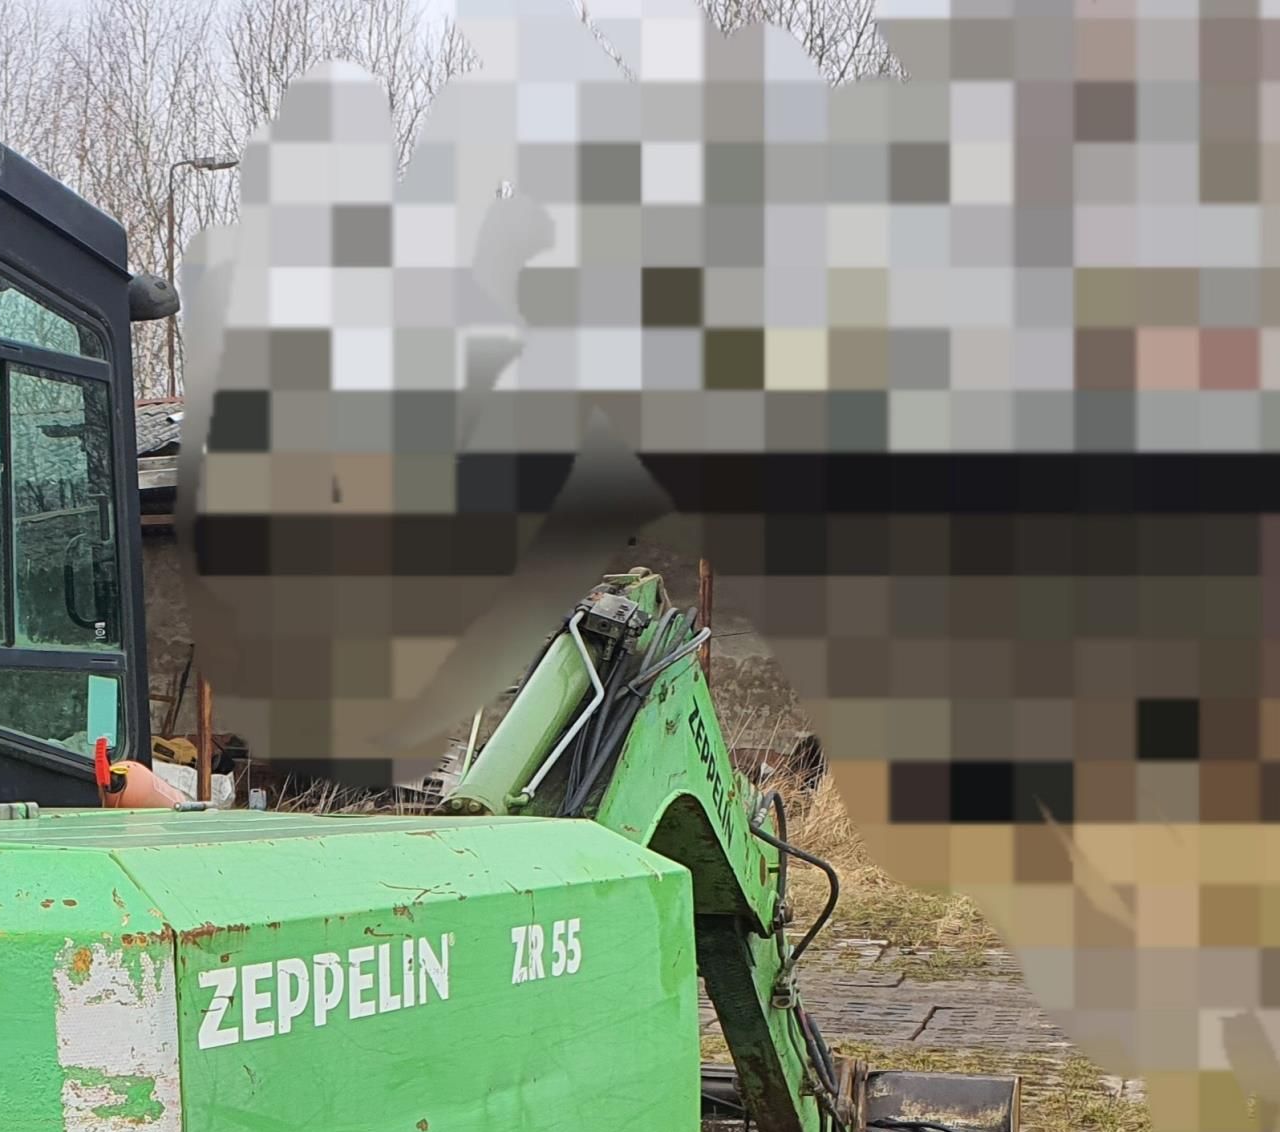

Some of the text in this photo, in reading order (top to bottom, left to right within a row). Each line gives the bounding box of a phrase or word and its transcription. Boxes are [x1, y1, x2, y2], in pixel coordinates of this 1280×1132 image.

[688, 695, 735, 849] ZEPPELIN
[198, 933, 449, 1050] ZEPPELIN
[511, 918, 582, 984] ZR 55
